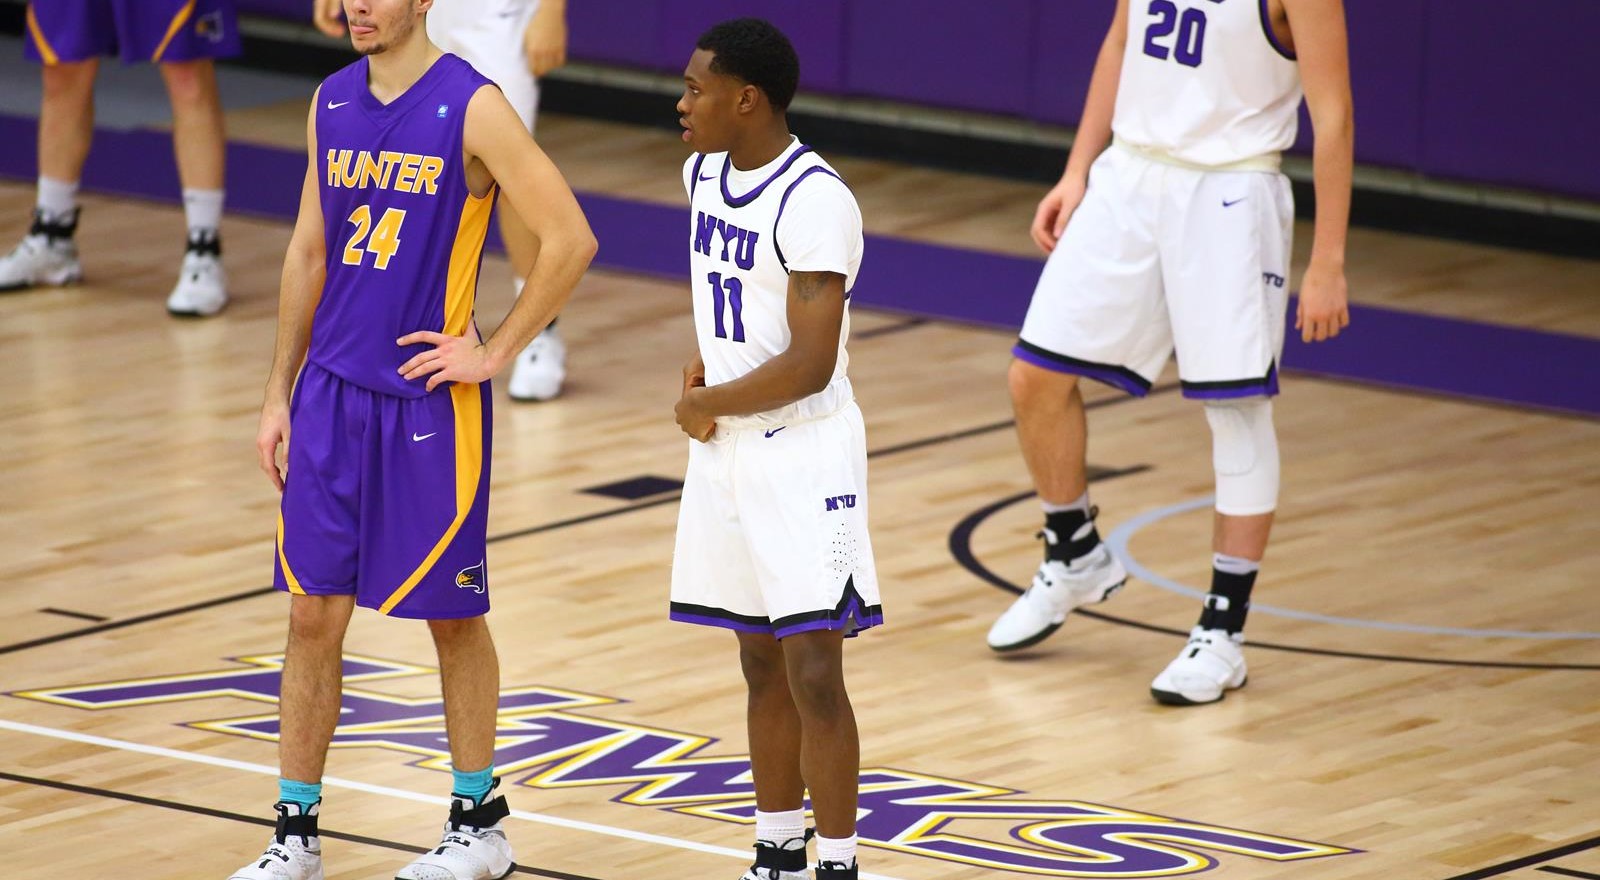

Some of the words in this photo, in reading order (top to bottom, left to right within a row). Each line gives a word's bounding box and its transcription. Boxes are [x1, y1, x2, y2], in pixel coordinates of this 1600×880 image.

[1142, 0, 1207, 68] 20
[326, 148, 444, 196] HUNTER
[341, 204, 407, 271] 24
[693, 210, 760, 271] NYU
[706, 270, 746, 343] 11
[1261, 271, 1285, 289] YU
[4, 653, 1366, 878] HAWKS
